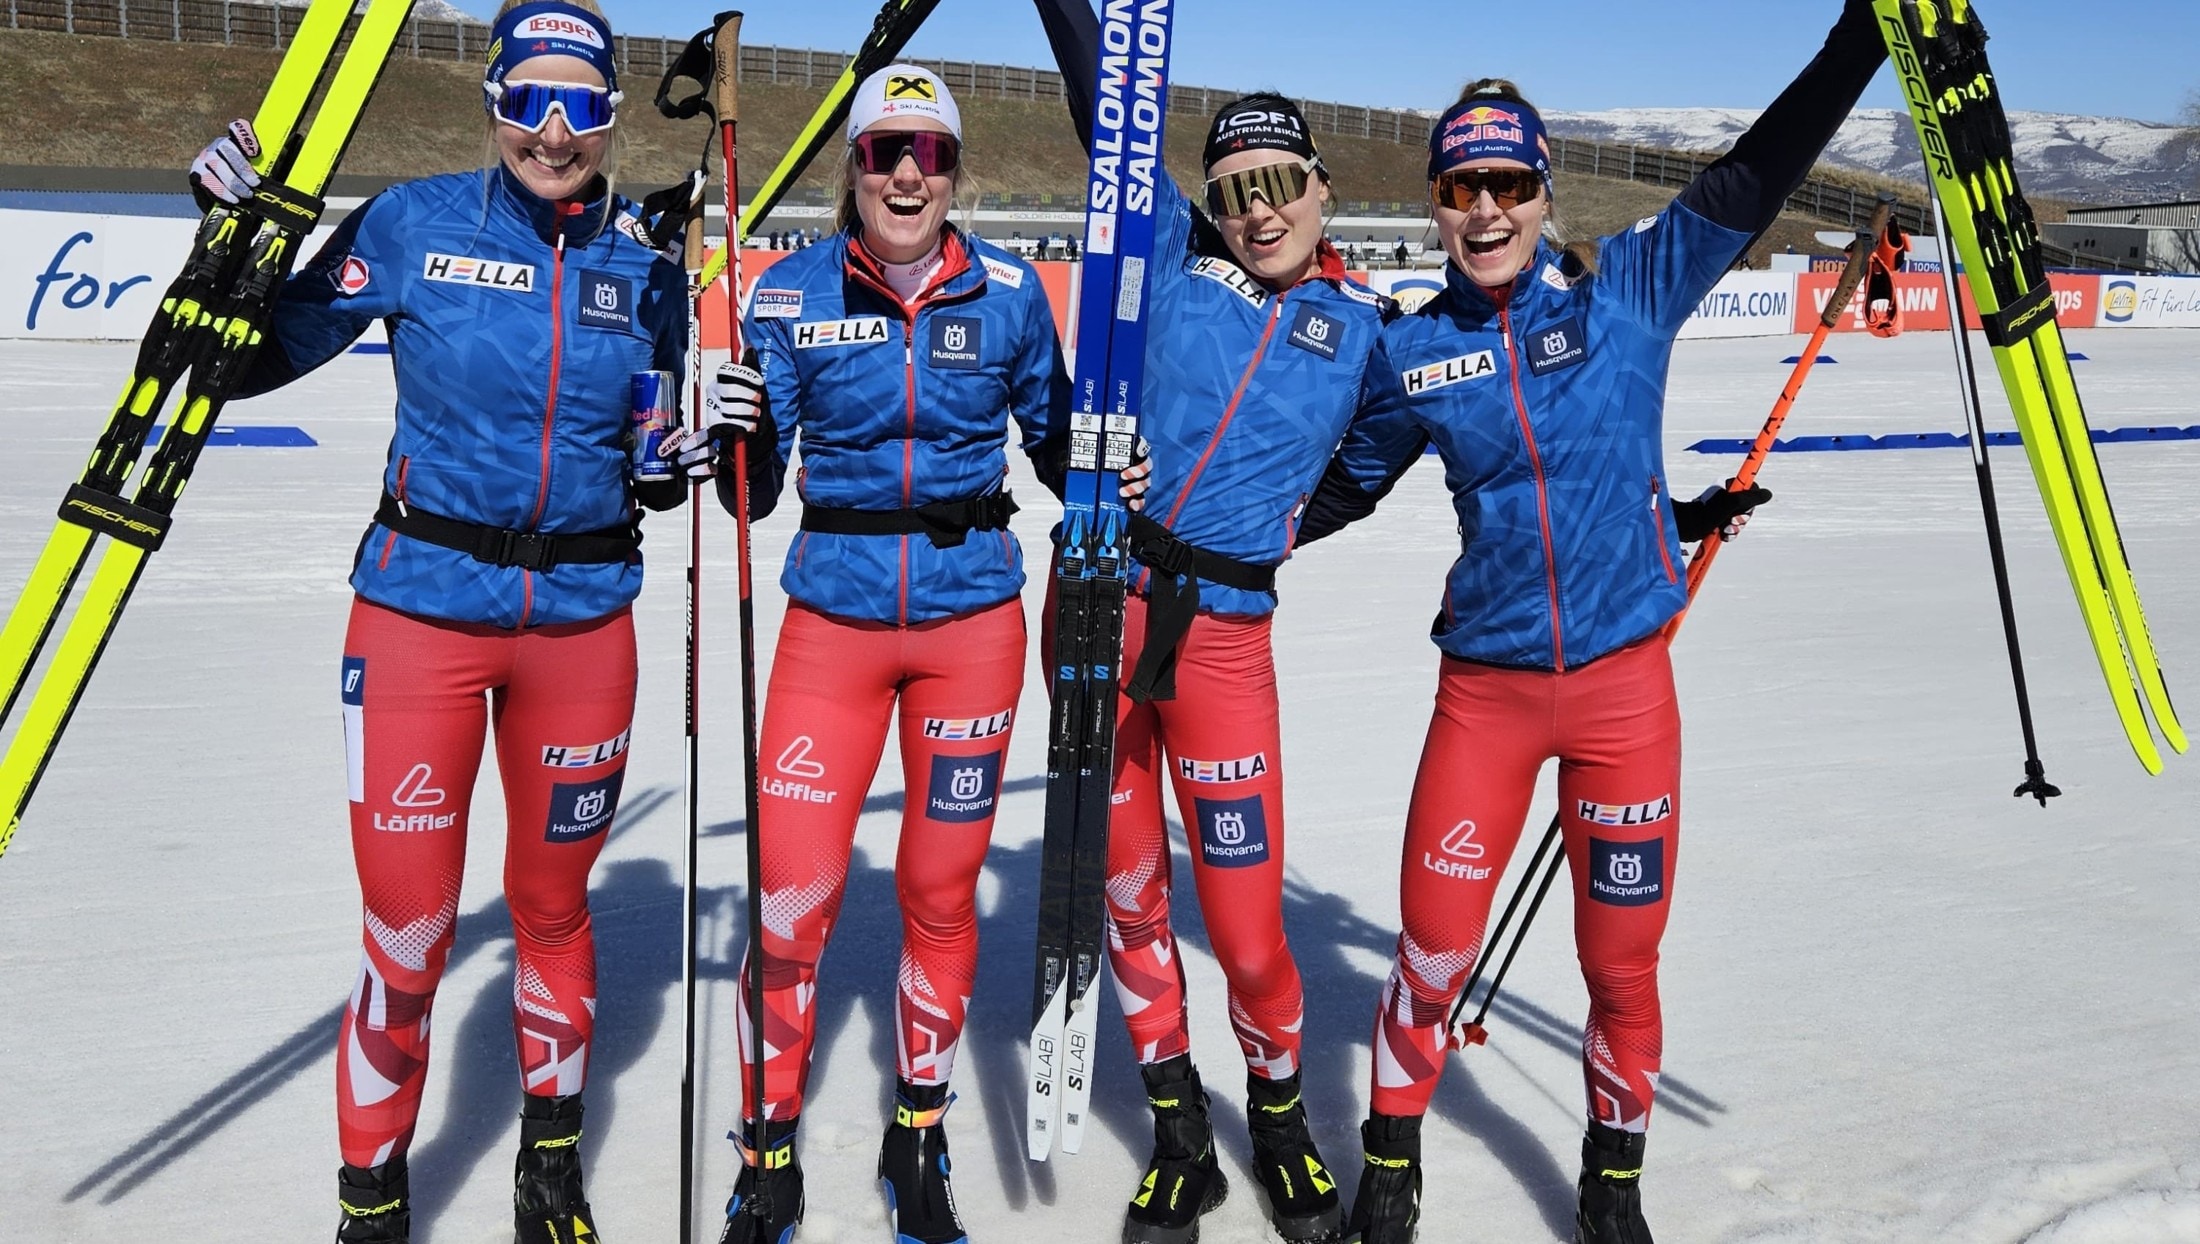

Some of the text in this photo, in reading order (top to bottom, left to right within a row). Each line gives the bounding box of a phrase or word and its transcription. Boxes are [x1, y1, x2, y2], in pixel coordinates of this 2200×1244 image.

[529, 17, 596, 42] Egger
[551, 41, 595, 59] Ski Austria
[915, 104, 940, 114] Austria
[1091, 0, 1134, 214] SALOMON
[1126, 0, 1169, 216] SALOMON
[1883, 15, 1953, 181] FISCHER
[234, 121, 256, 155] ener
[1215, 126, 1303, 144] AUSTRIAN BIKES
[1262, 138, 1289, 146] Austria
[1442, 125, 1523, 153] Red Bull
[1484, 145, 1513, 153] Austria
[254, 191, 317, 221] CHER
[772, 208, 810, 216] OLDIER
[1053, 212, 1085, 220] HOLLO
[427, 257, 529, 289] HELLA
[986, 264, 1017, 281] öffler
[1913, 262, 1941, 273] 100%
[26, 231, 152, 330] for
[1194, 257, 1266, 305] HELLA
[757, 305, 782, 313] SPORT
[758, 294, 792, 303] POLIZEI
[1689, 292, 1787, 318] AVITA.COM
[2140, 287, 2200, 319] Fit fürs Le
[582, 306, 629, 324] Husqvarna
[798, 321, 886, 345] HELLA
[1292, 330, 1335, 353] Husqvarna
[761, 338, 771, 370] Ausria
[932, 350, 977, 361] Husqvarna
[1535, 347, 1582, 368] Husqvarna
[1408, 354, 1493, 392] HELLA
[67, 498, 161, 537] FISCHER
[925, 710, 1011, 739] HELLA
[543, 727, 631, 766] HELLA
[1182, 755, 1266, 782] HELLA
[762, 776, 837, 804] Löffler
[932, 796, 993, 813] Husqvarna
[1579, 797, 1671, 825] HELLA
[374, 812, 457, 832] Löffler
[552, 810, 613, 833] Husqvarna
[1204, 842, 1264, 858] Husqvarna
[1424, 852, 1492, 880] Löffler
[1593, 879, 1659, 897] Husqvarna
[1149, 1096, 1179, 1108] CHER
[1262, 1092, 1302, 1114] FISCH
[534, 1130, 583, 1149] FISCH
[1364, 1152, 1409, 1168] SCHER
[1601, 1168, 1643, 1179] FISCH
